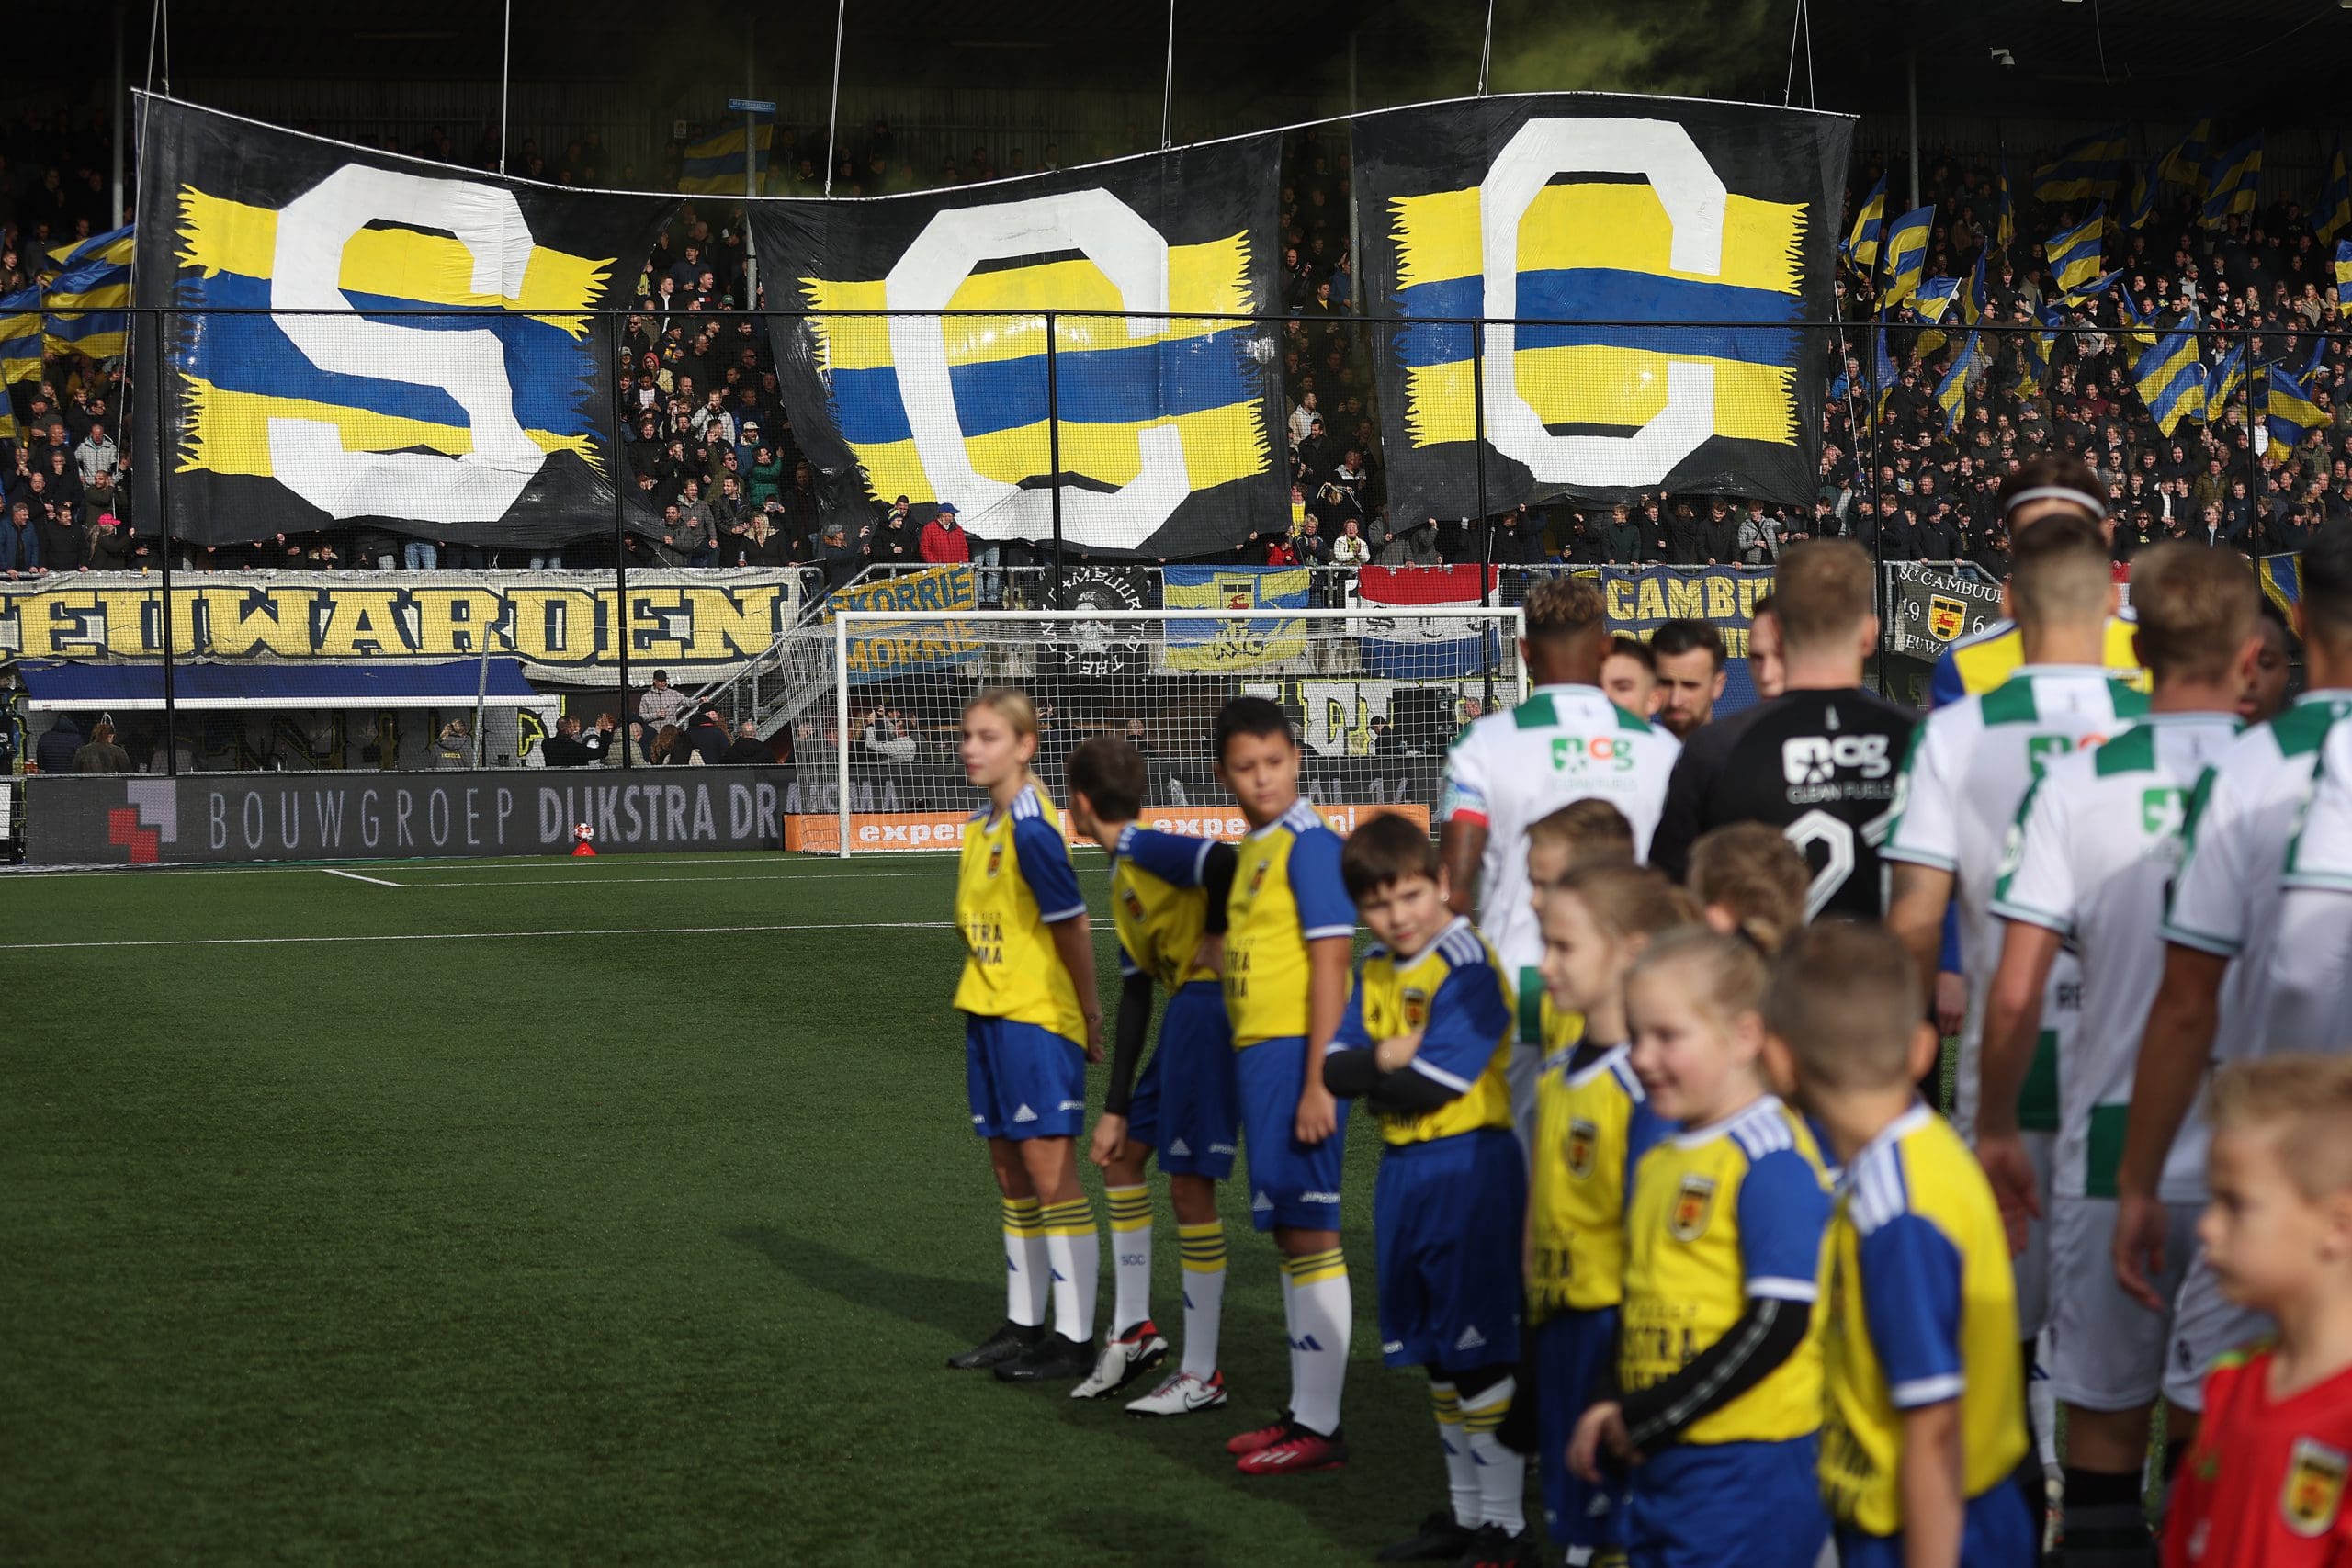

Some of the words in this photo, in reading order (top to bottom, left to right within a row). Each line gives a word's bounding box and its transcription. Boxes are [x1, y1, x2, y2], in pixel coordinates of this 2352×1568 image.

[1606, 576, 1778, 621] CAMBU
[1899, 568, 1919, 582] SC
[0, 585, 781, 661] EUWARDEN
[209, 787, 514, 850] BOUWGROEP
[538, 783, 717, 843] DIJKSTRA
